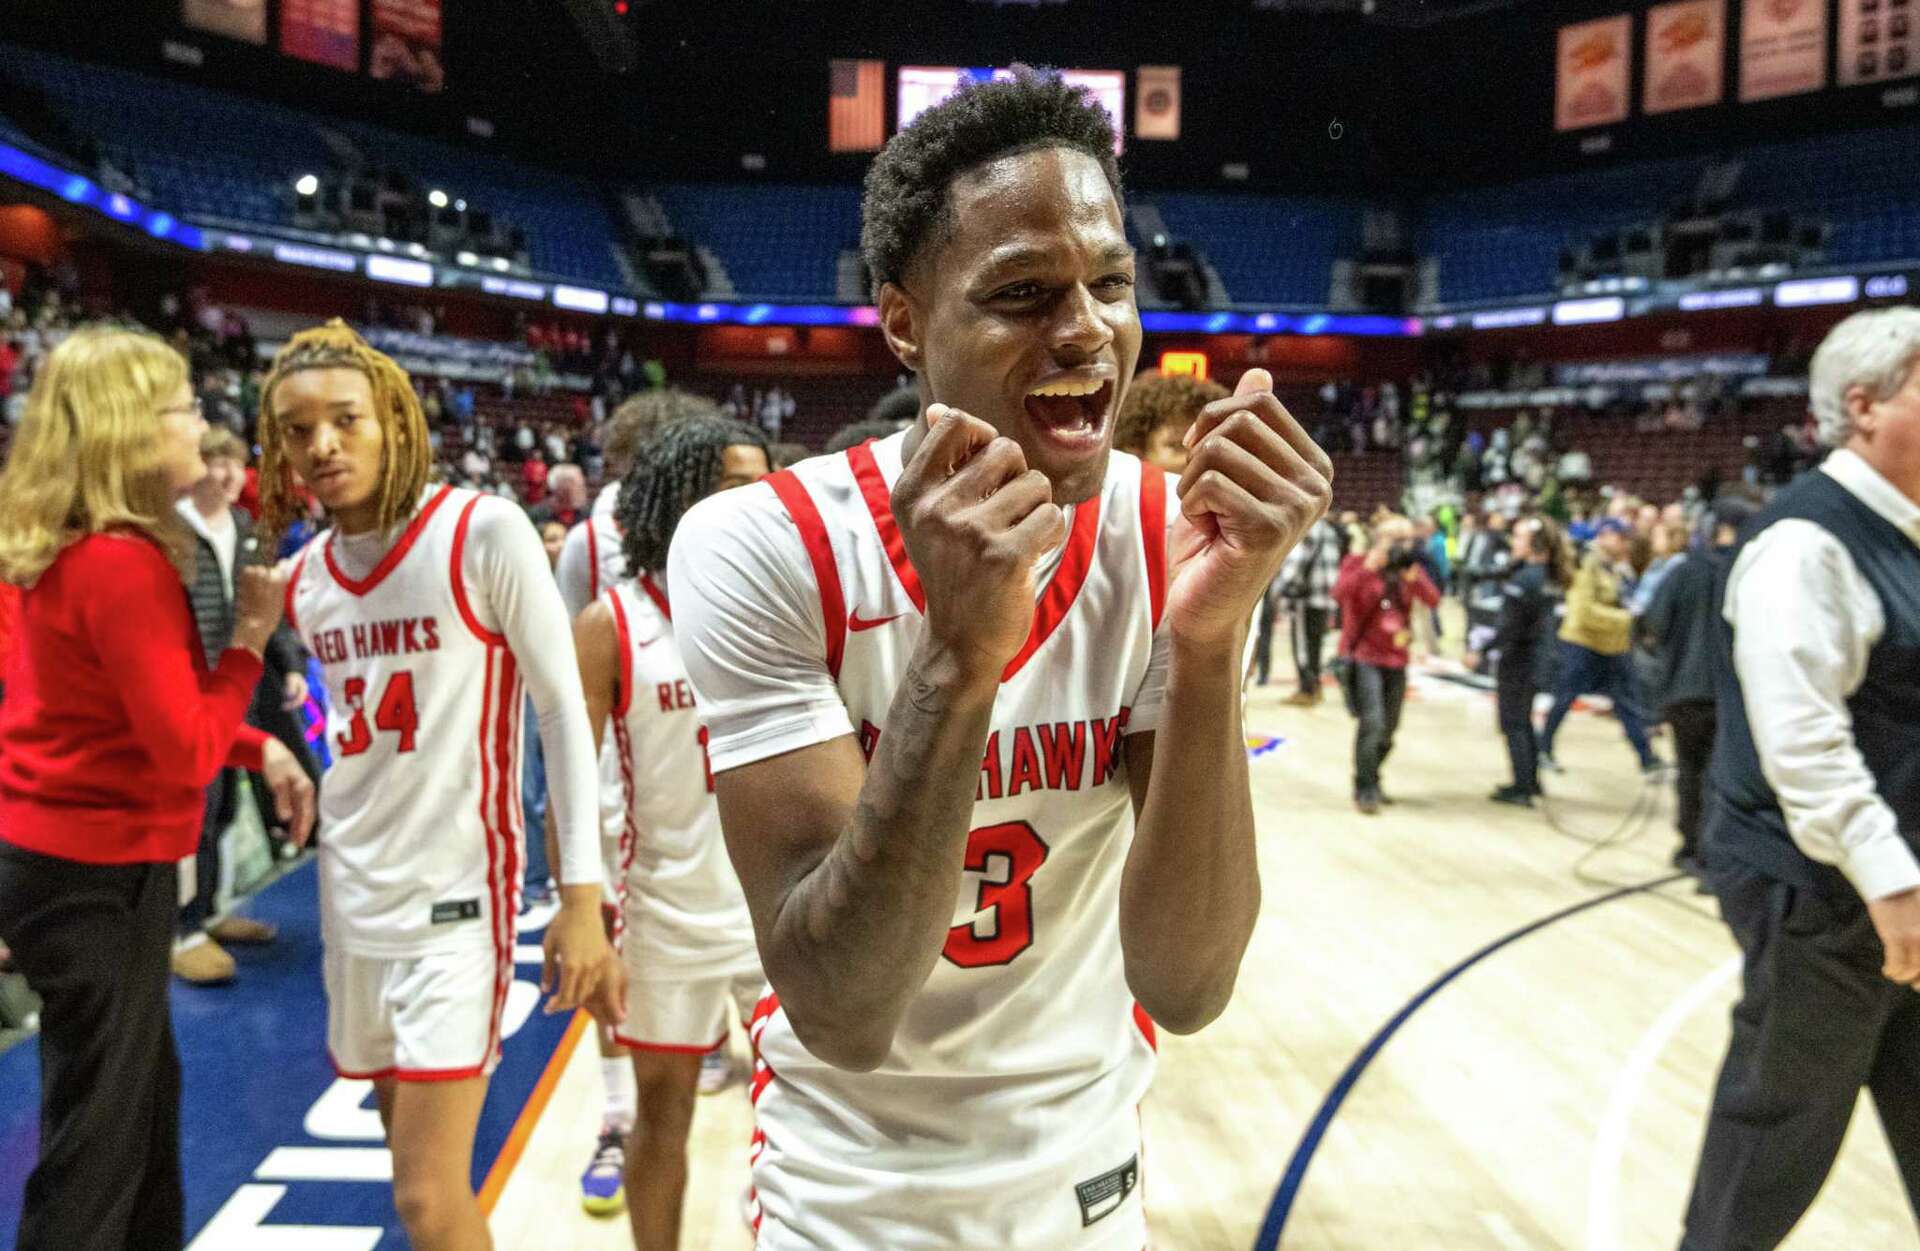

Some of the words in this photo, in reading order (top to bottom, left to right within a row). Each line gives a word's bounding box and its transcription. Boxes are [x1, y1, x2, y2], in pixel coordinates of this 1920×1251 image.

[313, 628, 348, 664] RED
[352, 616, 440, 659] HAWKS
[336, 670, 419, 757] 34
[657, 679, 697, 712] RE
[975, 706, 1132, 801] HAWK
[942, 819, 1050, 969] 3
